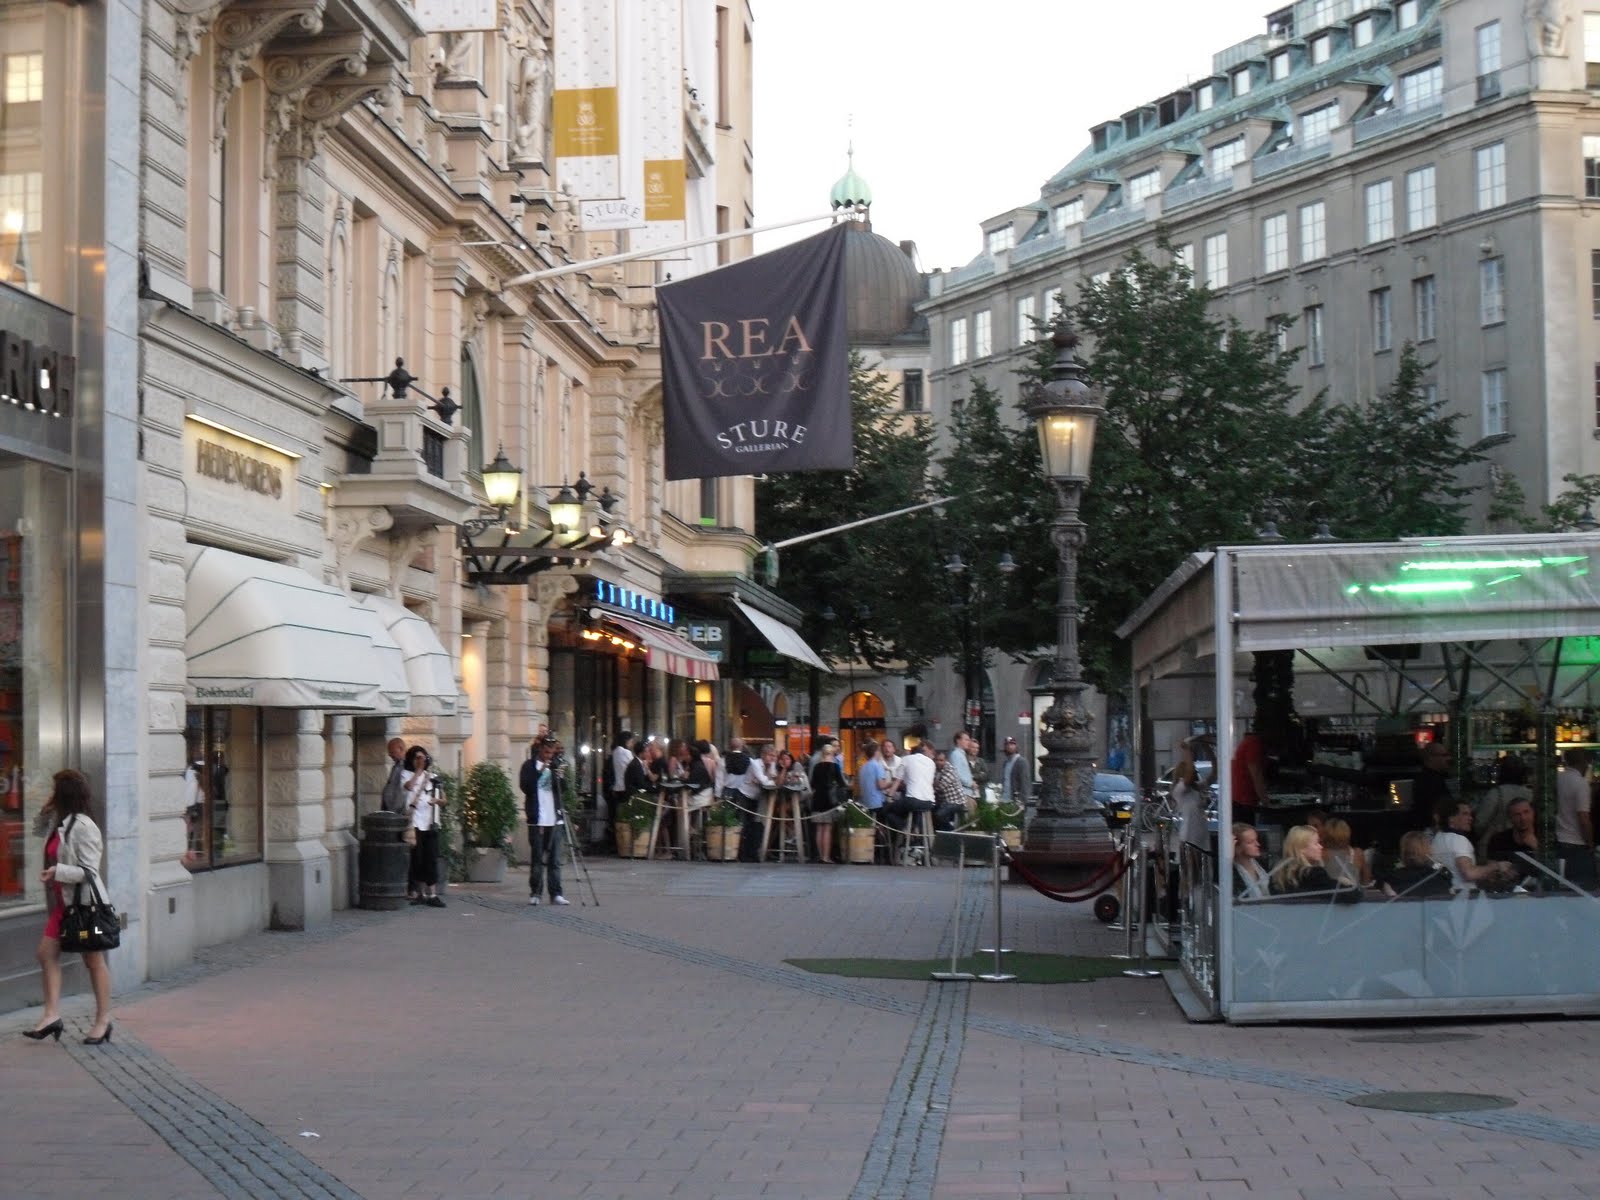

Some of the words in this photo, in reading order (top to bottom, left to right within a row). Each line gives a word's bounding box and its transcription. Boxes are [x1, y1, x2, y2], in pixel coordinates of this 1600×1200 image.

[585, 203, 641, 220] STURE
[700, 315, 813, 360] REA
[716, 419, 808, 449] STURE
[735, 442, 790, 453] GALLERIAN
[676, 626, 722, 642] SEB
